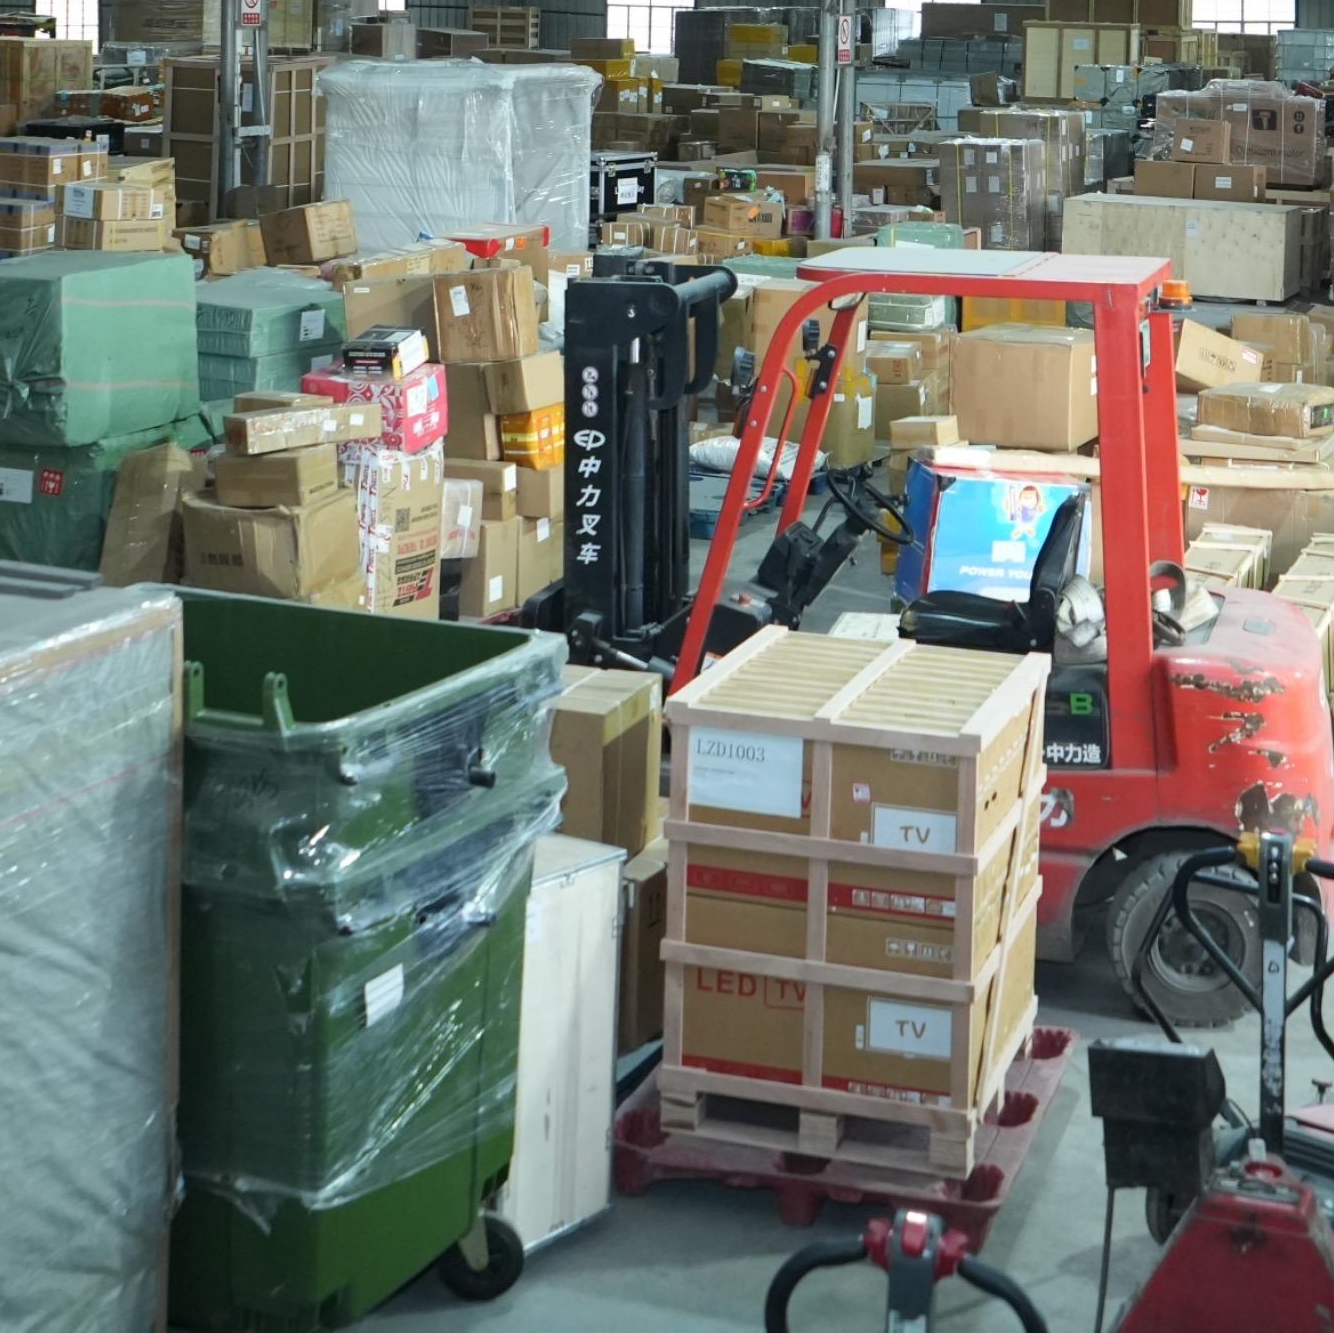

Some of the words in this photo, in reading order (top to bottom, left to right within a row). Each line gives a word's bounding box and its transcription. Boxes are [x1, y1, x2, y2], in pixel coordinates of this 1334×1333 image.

[575, 455, 603, 566] 中力叉车
[959, 565, 1005, 579] POWER
[695, 738, 766, 763] LZD1003
[899, 825, 931, 844] TV
[696, 966, 758, 998] LED
[896, 1019, 927, 1039] TV
